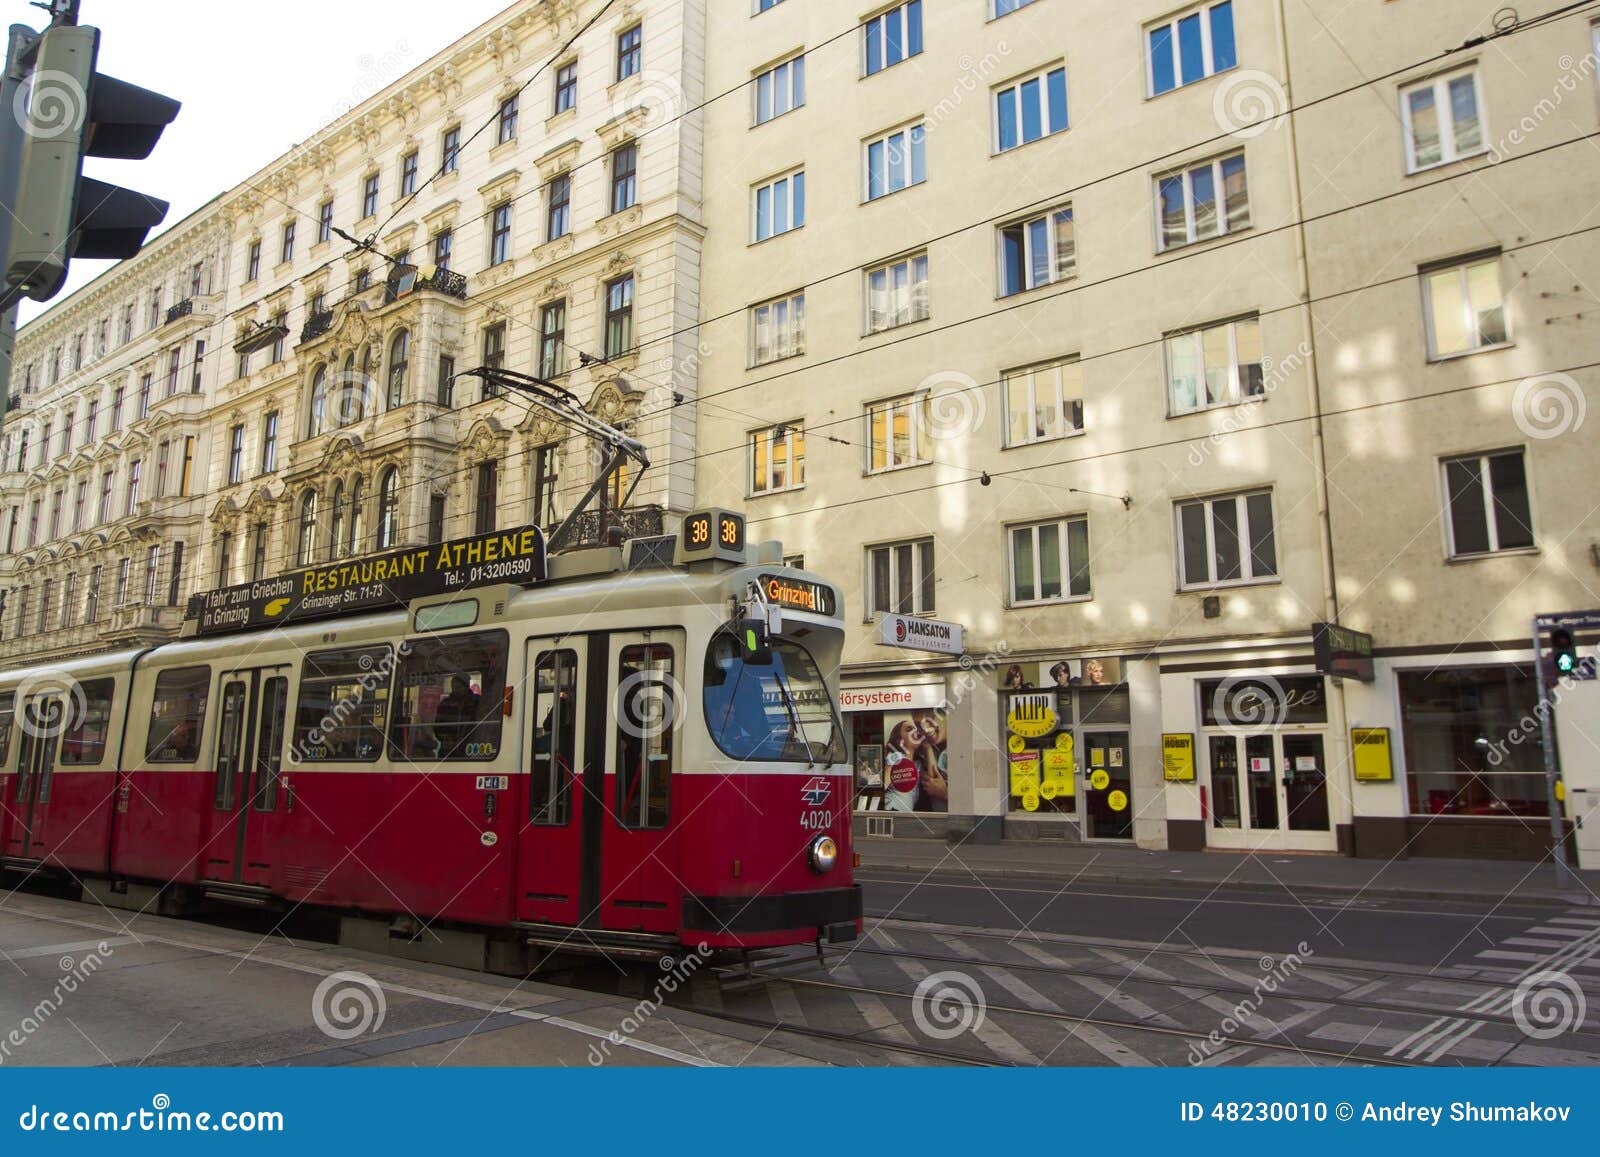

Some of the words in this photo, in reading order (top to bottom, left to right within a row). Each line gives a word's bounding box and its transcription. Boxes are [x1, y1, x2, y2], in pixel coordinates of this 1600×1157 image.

[692, 520, 708, 543] 38
[721, 520, 736, 543] 38
[302, 551, 430, 594] RESTAURANT
[436, 530, 535, 570] ATHENE
[444, 571, 465, 586] Tel.:
[470, 558, 531, 582] 01-3200590
[231, 589, 250, 604] zum
[251, 579, 293, 600] Griechen
[301, 593, 342, 609] Grinzinger
[344, 589, 358, 602] Str.
[360, 584, 383, 599] 71-73
[768, 580, 815, 609] Grinzing
[203, 610, 212, 626] in
[213, 605, 250, 625] Grinzing
[908, 621, 951, 640] HANSATON
[1015, 695, 1049, 720] KLIPP
[800, 810, 832, 829] 4020
